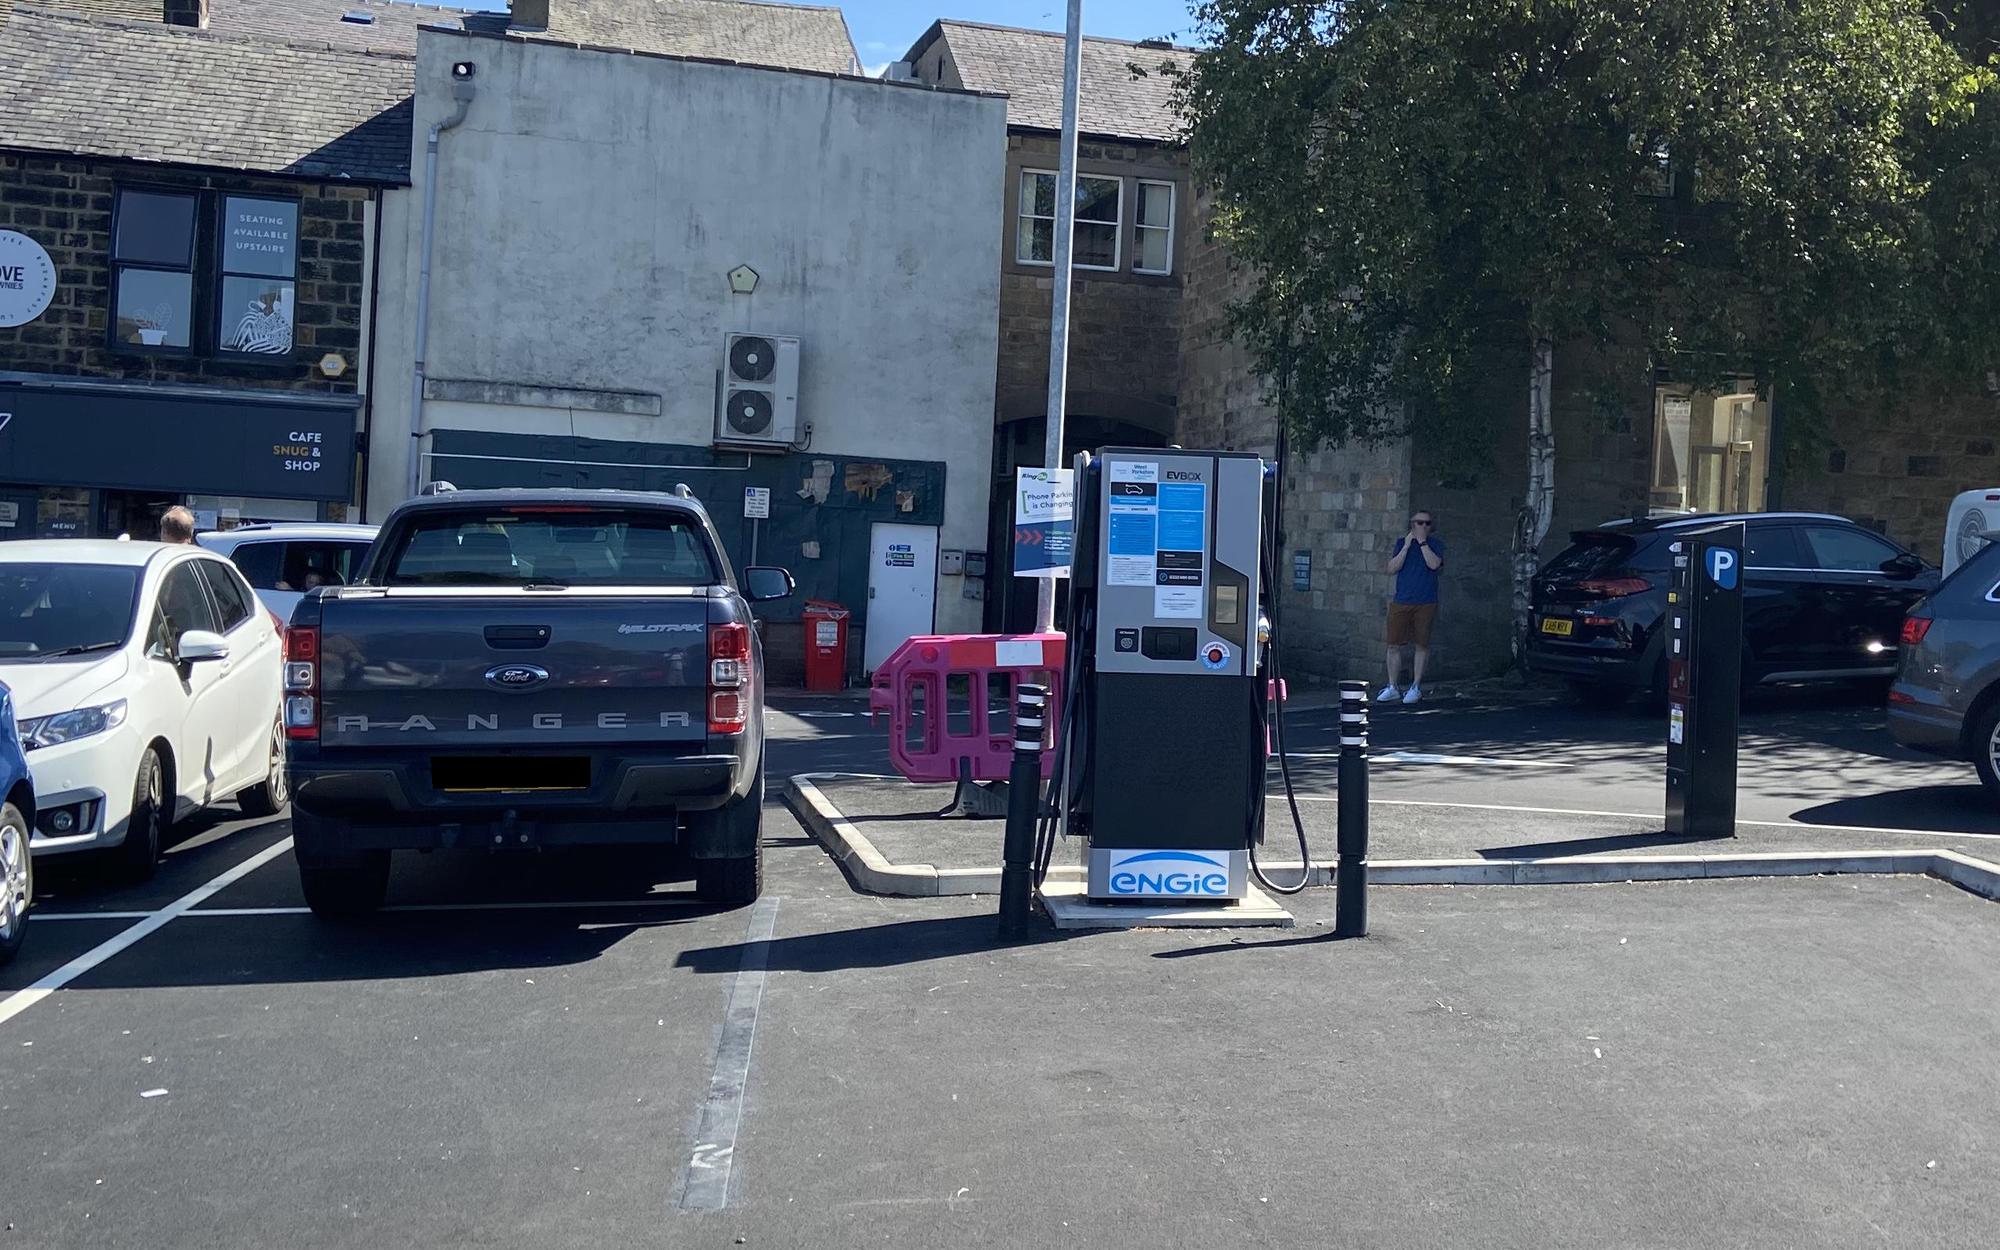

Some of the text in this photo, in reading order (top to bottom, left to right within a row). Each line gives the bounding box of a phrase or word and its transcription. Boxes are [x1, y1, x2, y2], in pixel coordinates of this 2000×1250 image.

[240, 214, 283, 225] SEATING
[233, 228, 288, 240] AVAILABLE
[236, 242, 284, 253] UPSTAIRS
[0, 266, 24, 281] VE
[289, 431, 322, 443] CAFE
[273, 445, 321, 457] SNUG &
[284, 460, 321, 471] SHOP
[1166, 471, 1201, 481] EVBOX
[1051, 490, 1073, 499] Parkin
[52, 522, 76, 530] MENU
[1713, 551, 1734, 581] P
[503, 670, 530, 682] Ford
[338, 711, 690, 732] RANGER
